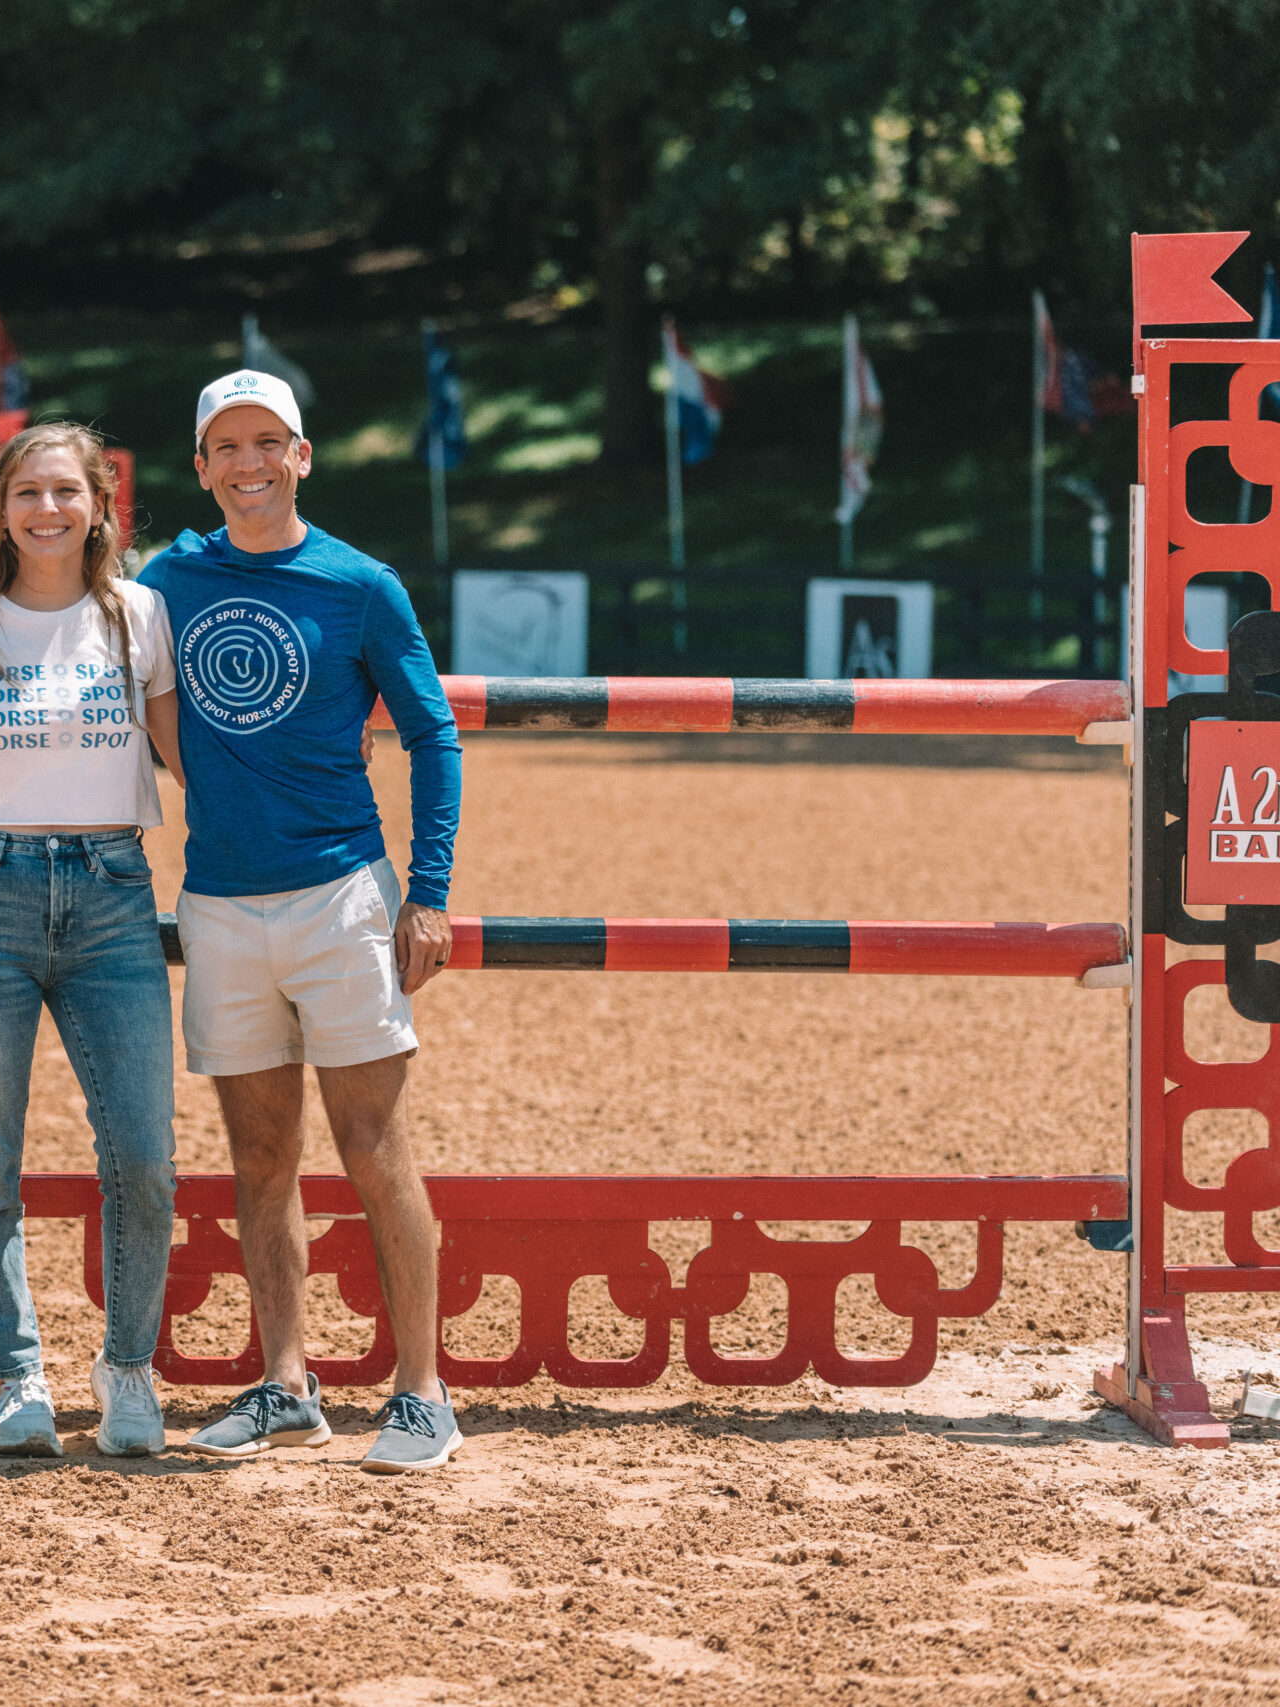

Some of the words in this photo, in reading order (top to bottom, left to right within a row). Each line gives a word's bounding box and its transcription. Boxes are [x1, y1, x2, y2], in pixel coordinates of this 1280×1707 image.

[184, 616, 215, 653] HORSE
[215, 609, 247, 623] SPOT
[254, 612, 289, 643] HORSE
[283, 641, 299, 675] SPOT
[184, 662, 206, 702] HORSE
[202, 699, 231, 721] SPOT
[237, 706, 274, 725] HORSE
[272, 682, 296, 712] SPOT
[82, 707, 133, 725] SPOT
[80, 731, 132, 749] SPOT
[1210, 765, 1280, 825] A2
[1216, 833, 1280, 859] BA
